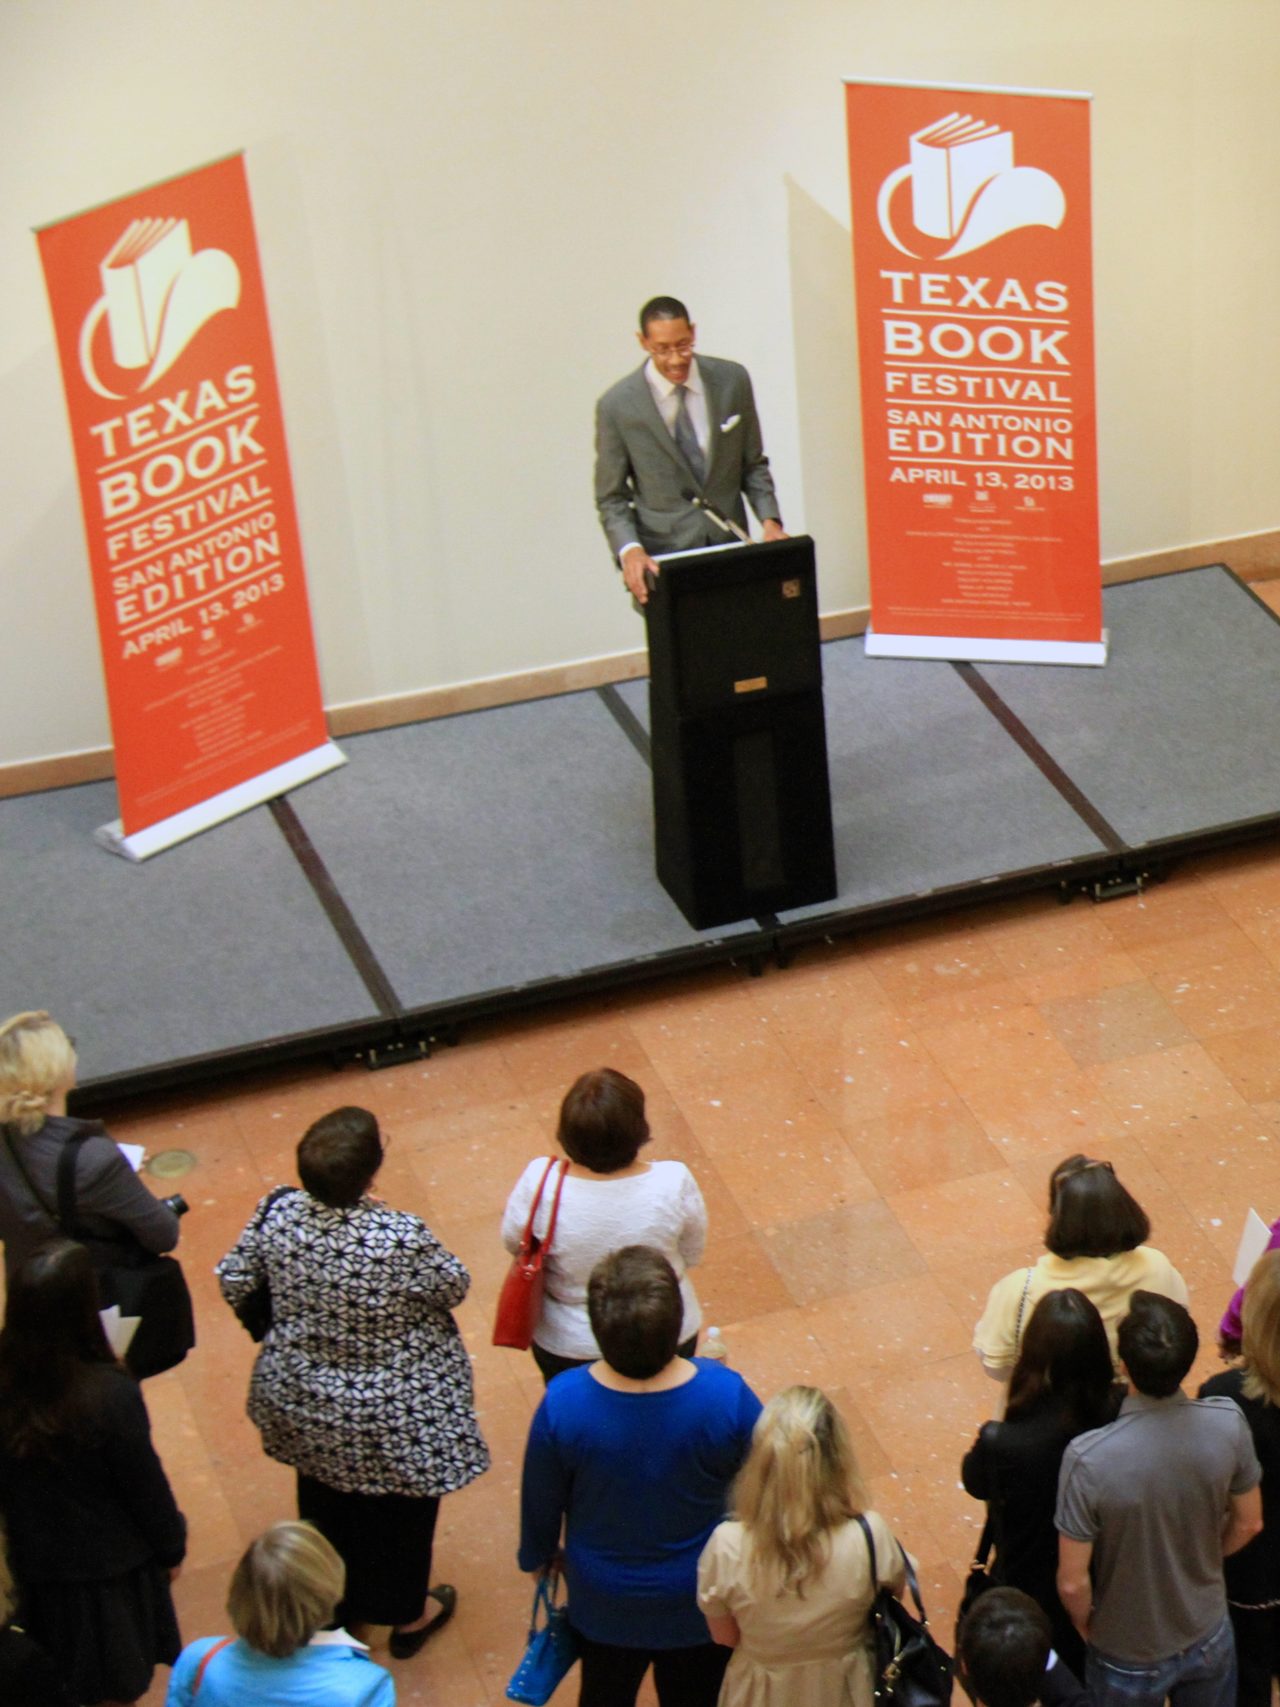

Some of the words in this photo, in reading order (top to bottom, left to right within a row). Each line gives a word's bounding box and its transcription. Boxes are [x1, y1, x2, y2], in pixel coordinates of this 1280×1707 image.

[880, 269, 1069, 313] TEXAS
[883, 319, 1070, 365] BOOK
[90, 365, 256, 457] TEXAS
[885, 371, 1072, 402] FESTIVAL
[887, 409, 942, 427] SAN
[949, 412, 1072, 434] ANTONIO
[888, 428, 1073, 460] EDITION
[99, 415, 265, 519] BOOK
[890, 467, 966, 486] APRIL
[974, 471, 1008, 490] 13,
[1014, 473, 1074, 491] 2013
[107, 476, 271, 561] FESTIVAL
[113, 560, 165, 595] SAN
[169, 511, 276, 572] ANTONIO
[115, 531, 280, 624] EDITION
[122, 618, 194, 659] APRIL
[233, 573, 285, 609] 2013
